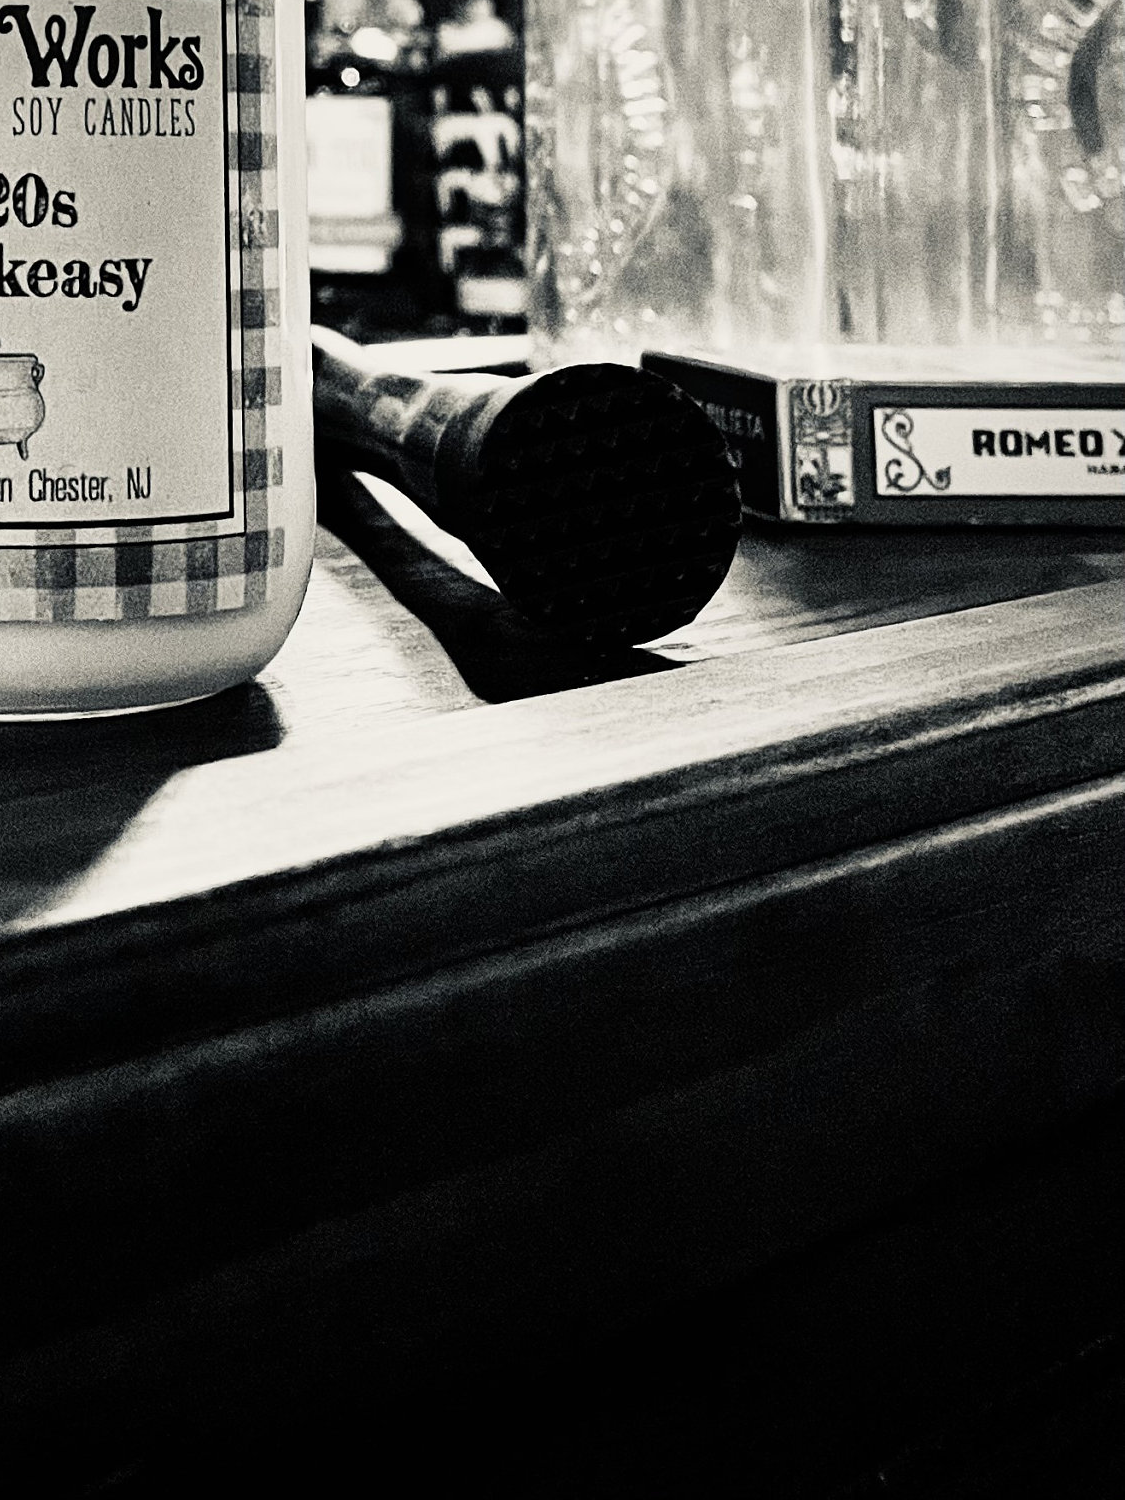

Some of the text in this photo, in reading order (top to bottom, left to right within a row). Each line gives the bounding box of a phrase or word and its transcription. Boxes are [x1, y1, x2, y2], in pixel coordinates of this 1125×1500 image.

[12, 97, 63, 136] SOY
[84, 98, 197, 137] CANDLES
[972, 429, 1103, 457] ROMEO
[28, 468, 113, 502] Chester,
[127, 466, 151, 499] NJ
